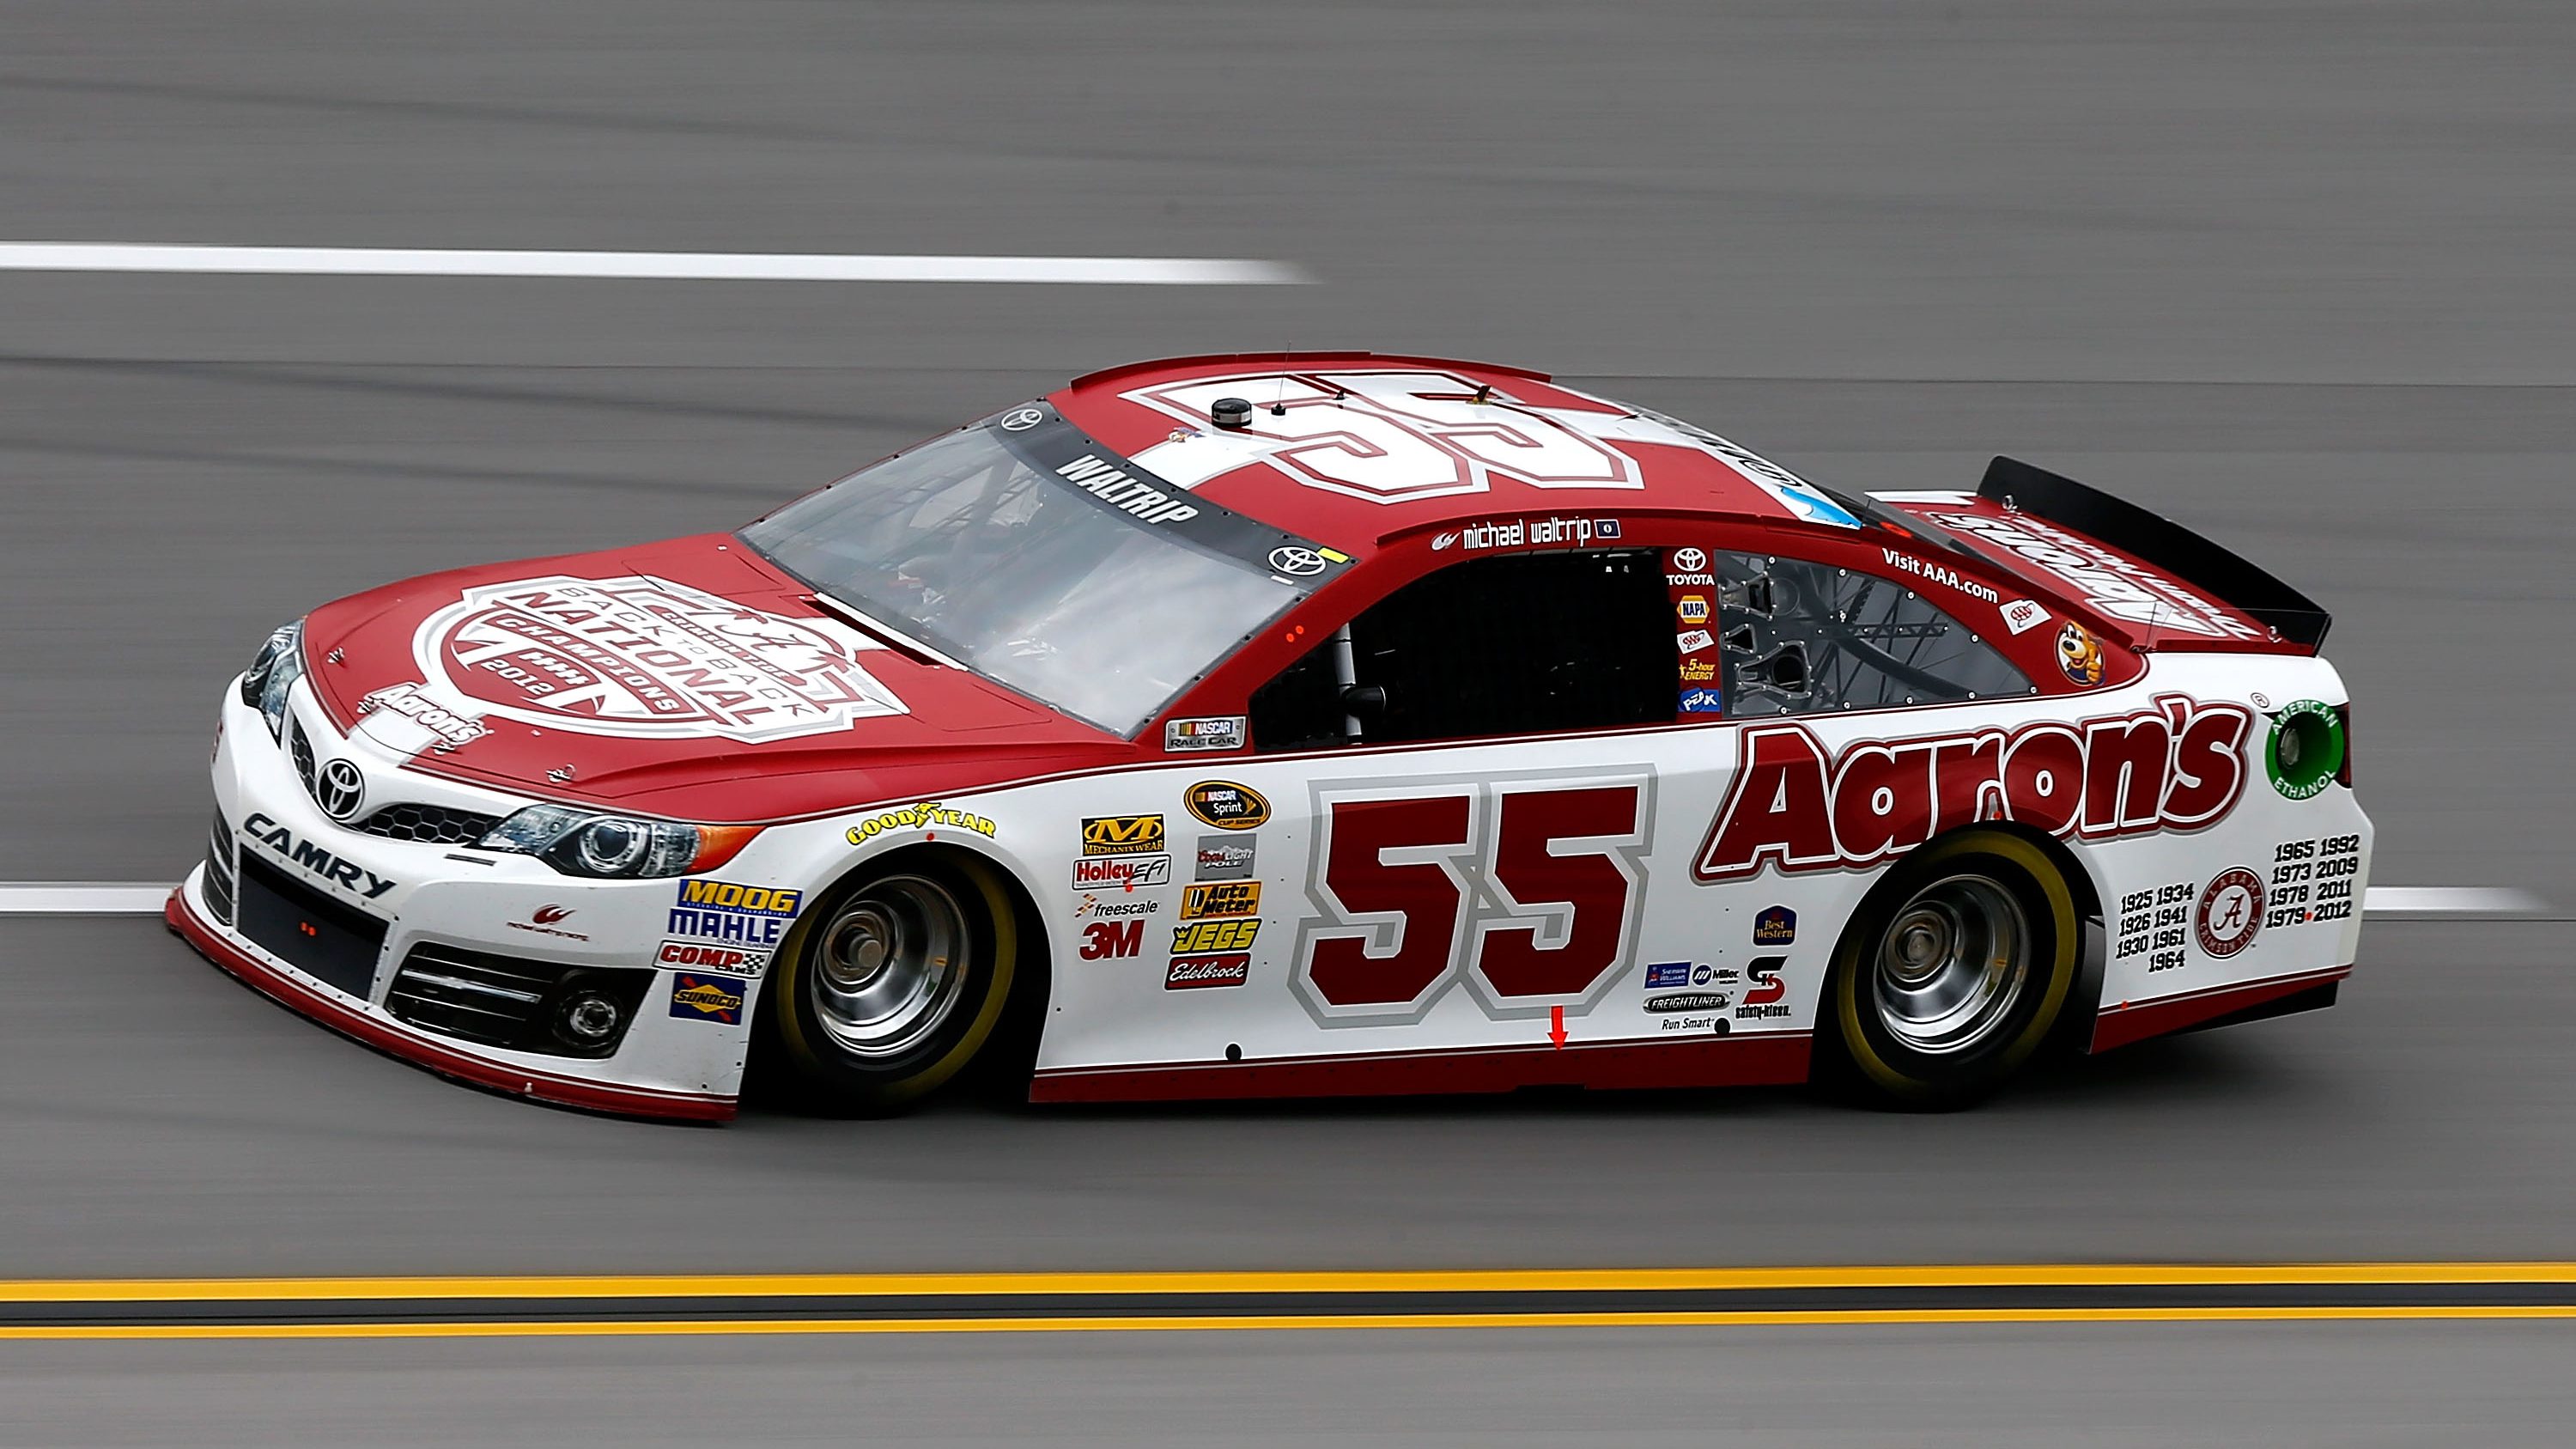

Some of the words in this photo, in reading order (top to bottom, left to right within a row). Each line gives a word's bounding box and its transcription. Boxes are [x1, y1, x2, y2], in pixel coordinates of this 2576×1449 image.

[1123, 371, 1642, 502] 55
[1055, 454, 1199, 524] WALTRIP
[1463, 518, 1524, 550] michael
[1531, 516, 1591, 547] waltrip
[1666, 574, 1715, 586] TOYOTA
[1882, 547, 1920, 574] Visit
[1923, 563, 1998, 603] AAA.com
[1682, 602, 1706, 616] NAPA
[659, 611, 740, 655] CRIMSON
[495, 617, 681, 712] CHAMPIONS
[503, 591, 776, 725] NATIONAL
[1688, 658, 1716, 671] 5-hour
[480, 659, 556, 697] 2012
[706, 658, 815, 716] BACK
[1684, 671, 1715, 681] ENERGY
[367, 684, 483, 745] Aaron's
[1194, 721, 1231, 735] NASCAR
[2272, 700, 2339, 735] AMERICAN
[1170, 739, 1206, 747] RACE
[1207, 737, 1238, 746] CAR
[1207, 790, 1236, 802] NASCAR
[1700, 697, 2245, 873] Aaron's
[2274, 770, 2336, 799] ETHANOL
[1213, 801, 1242, 816] Sprint
[244, 812, 398, 899] CAMRY
[1084, 843, 1133, 855] MECHANIX
[1135, 839, 1163, 852] WEAR
[2275, 840, 2316, 862] 1965
[2319, 834, 2360, 857] 1992
[1077, 861, 1134, 885] Holley
[1204, 860, 1245, 869] POLE
[2271, 863, 2312, 885] 1973
[2316, 856, 2359, 880] 2009
[682, 880, 799, 913] MOOG
[1206, 885, 1250, 899] Auto
[1299, 774, 1648, 1017] 55
[2120, 889, 2154, 915] 1925
[2156, 883, 2195, 906] 1934
[2202, 873, 2263, 910] ALABAMA
[2269, 885, 2310, 907] 1978
[2316, 879, 2352, 901] 2011
[1093, 899, 1159, 917] freescale
[1203, 899, 1256, 913] Meter
[2265, 906, 2306, 928] 1979
[2313, 900, 2352, 922] 2012
[668, 909, 781, 943] MAHLE
[1756, 928, 1793, 939] Western
[1765, 920, 1785, 930] Best
[2119, 912, 2151, 937] 1926
[2153, 906, 2188, 928] 1941
[1079, 919, 1145, 960] 3M
[1172, 922, 1260, 952] JEGS
[2115, 935, 2149, 959] 1930
[2152, 928, 2186, 951] 1961
[660, 945, 744, 968] COMP
[714, 964, 756, 976] CAMS
[2148, 949, 2185, 973] 1964
[1170, 961, 1246, 982] Edelbrock
[676, 990, 741, 1008] SUNOCO
[1650, 996, 1722, 1010] FREIGHTLINER
[1662, 1019, 1680, 1030] Run
[1682, 1017, 1711, 1029] Smart
